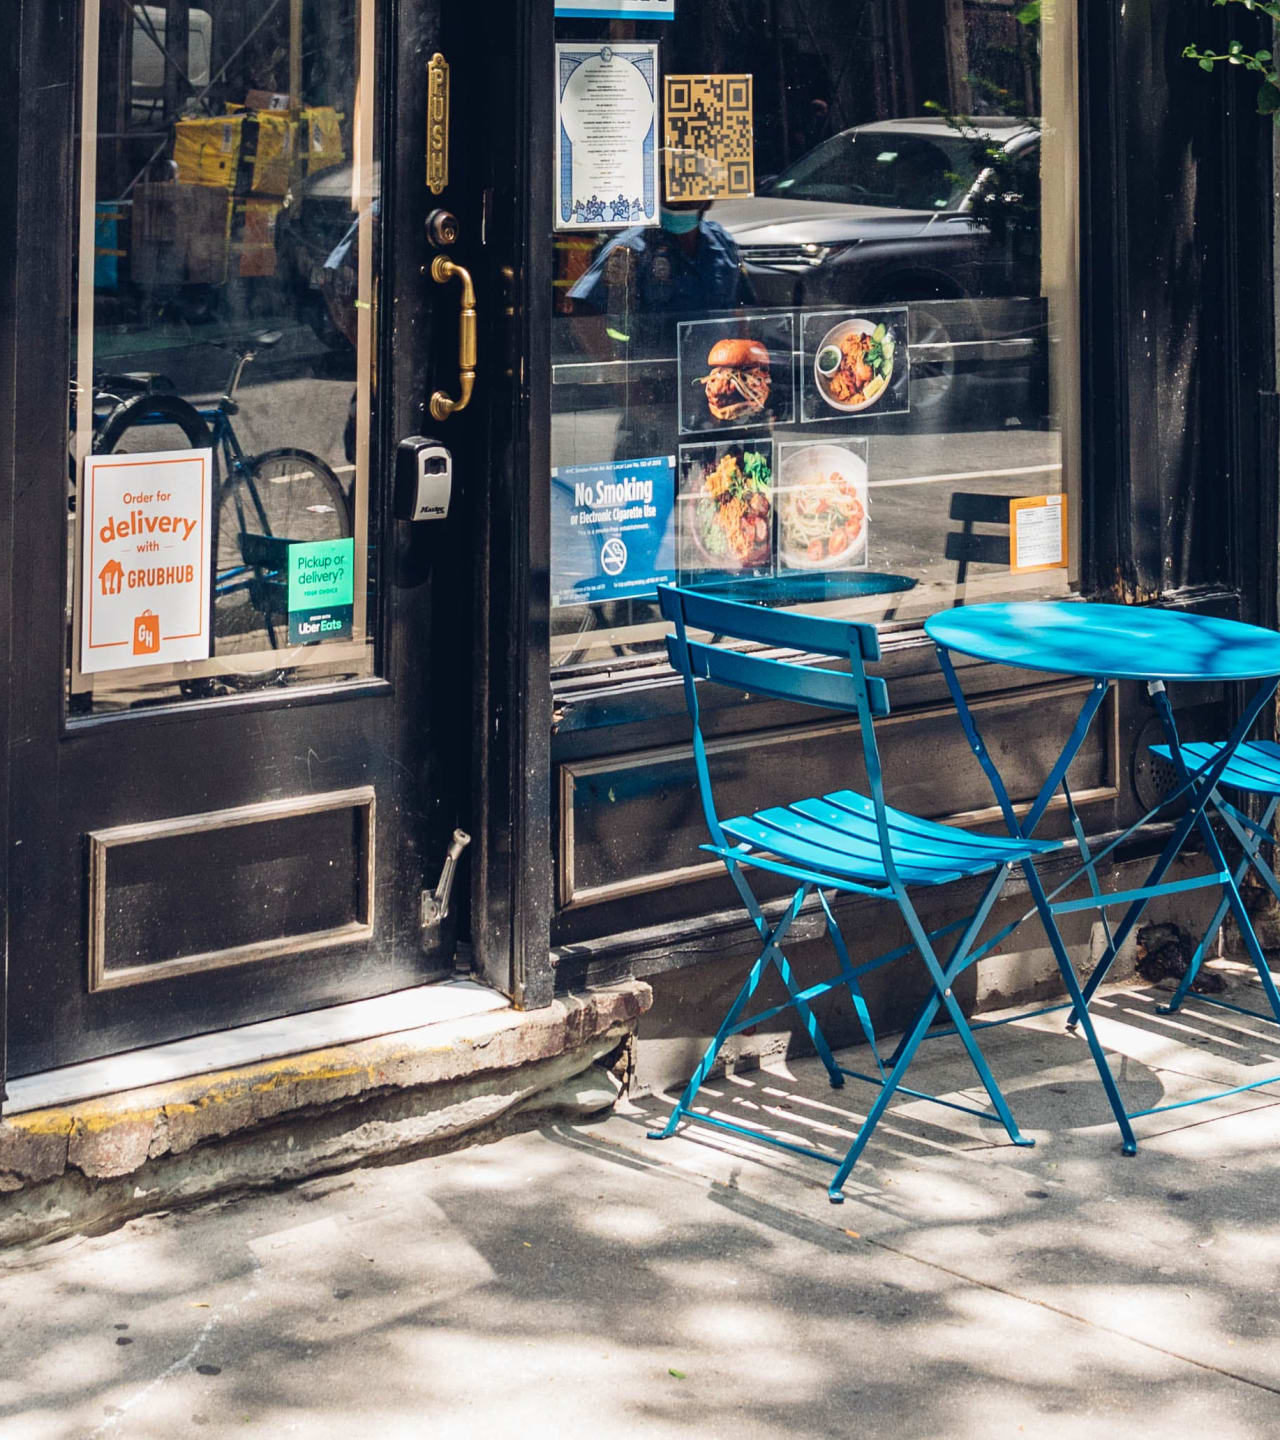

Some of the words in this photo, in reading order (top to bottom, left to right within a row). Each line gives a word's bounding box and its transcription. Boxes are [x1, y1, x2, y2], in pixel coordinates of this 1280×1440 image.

[431, 68, 444, 178] PUSH
[123, 492, 153, 504] Order
[156, 490, 171, 502] for
[575, 482, 593, 507] No
[596, 477, 653, 504] Smoking
[570, 515, 579, 525] or
[579, 508, 612, 525] Electronic
[613, 506, 642, 522] Cigarette
[643, 505, 657, 517] Use
[99, 510, 198, 544] delivery
[136, 540, 160, 553] with
[298, 556, 331, 569] Pickup
[334, 555, 345, 565] or
[127, 564, 194, 589] GRUBHUB
[298, 568, 344, 584] delivery?
[298, 622, 320, 634] Uber
[320, 620, 342, 631] Eats
